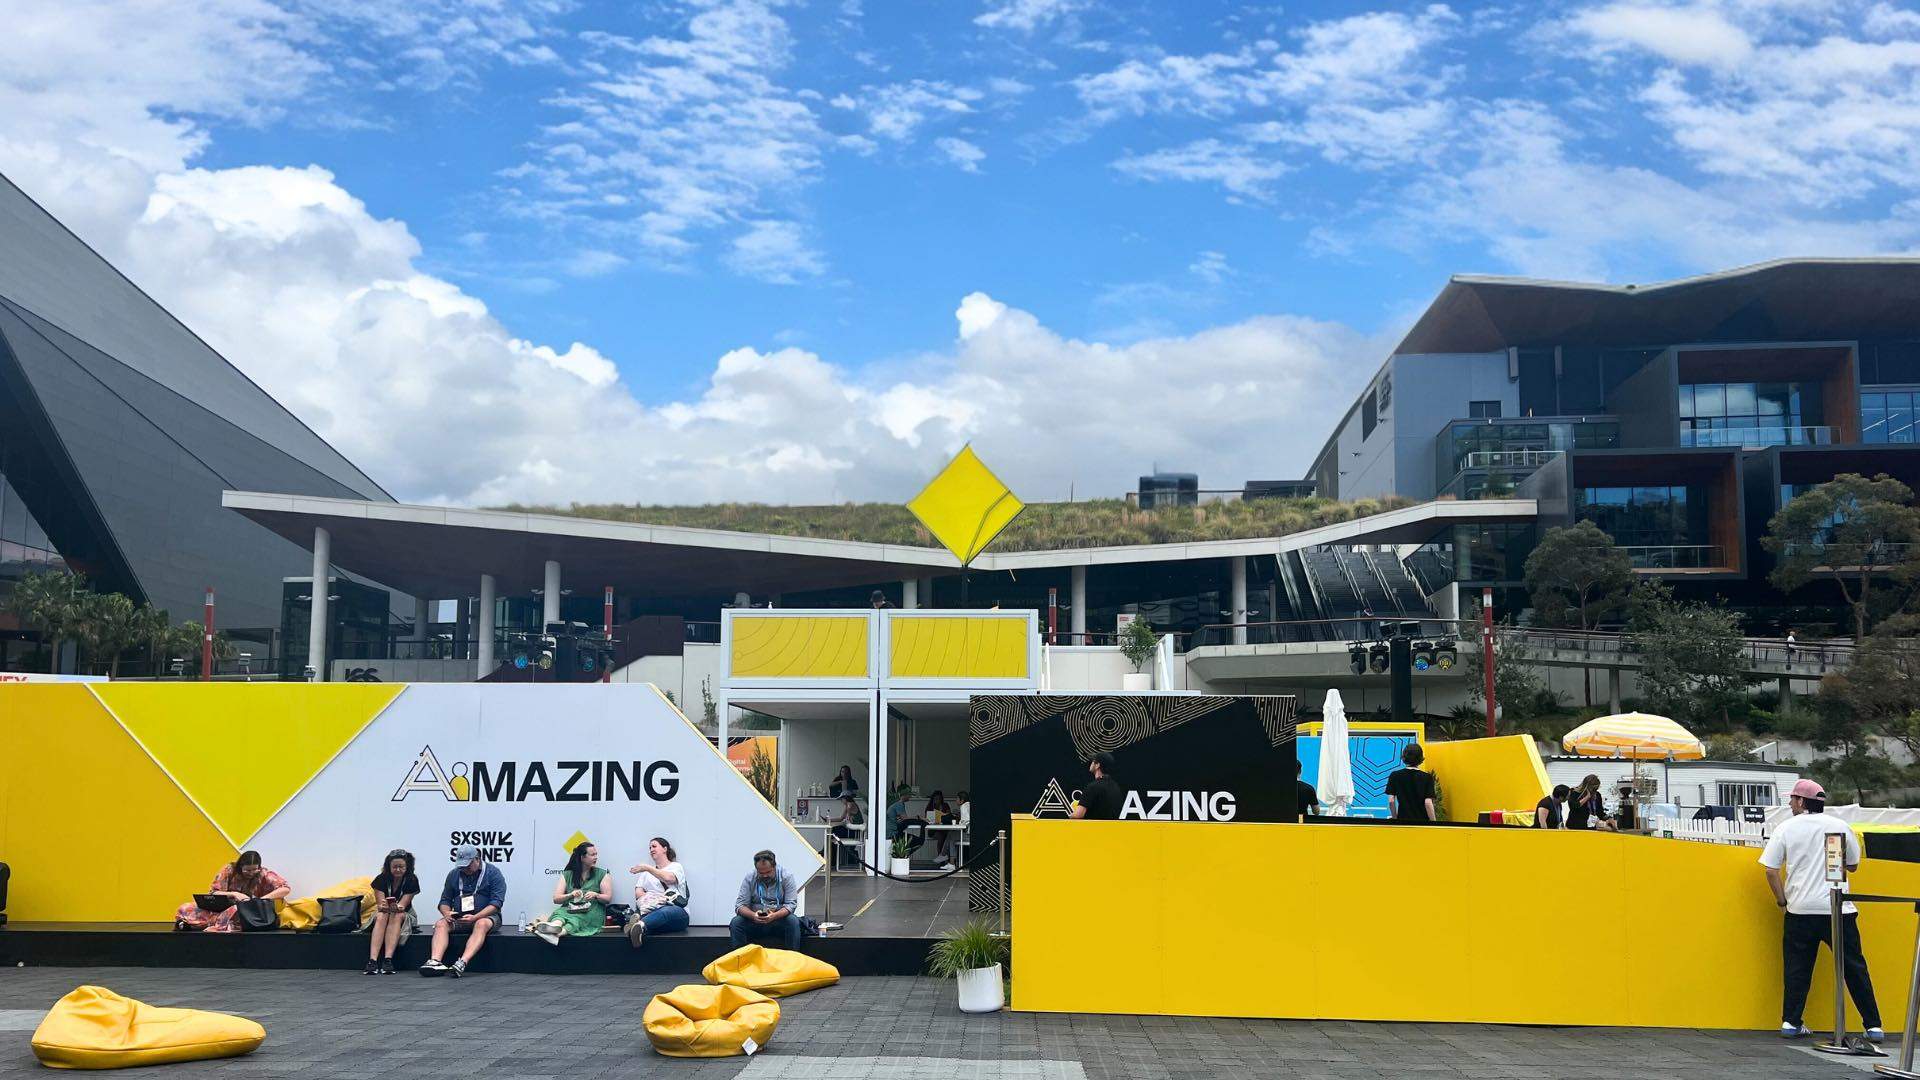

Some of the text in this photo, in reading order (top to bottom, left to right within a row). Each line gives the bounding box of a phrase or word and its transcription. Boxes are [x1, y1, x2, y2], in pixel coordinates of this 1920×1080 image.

[1031, 778, 1236, 821] AAZING
[450, 831, 496, 846] SXSW
[450, 848, 514, 862] SNEY
